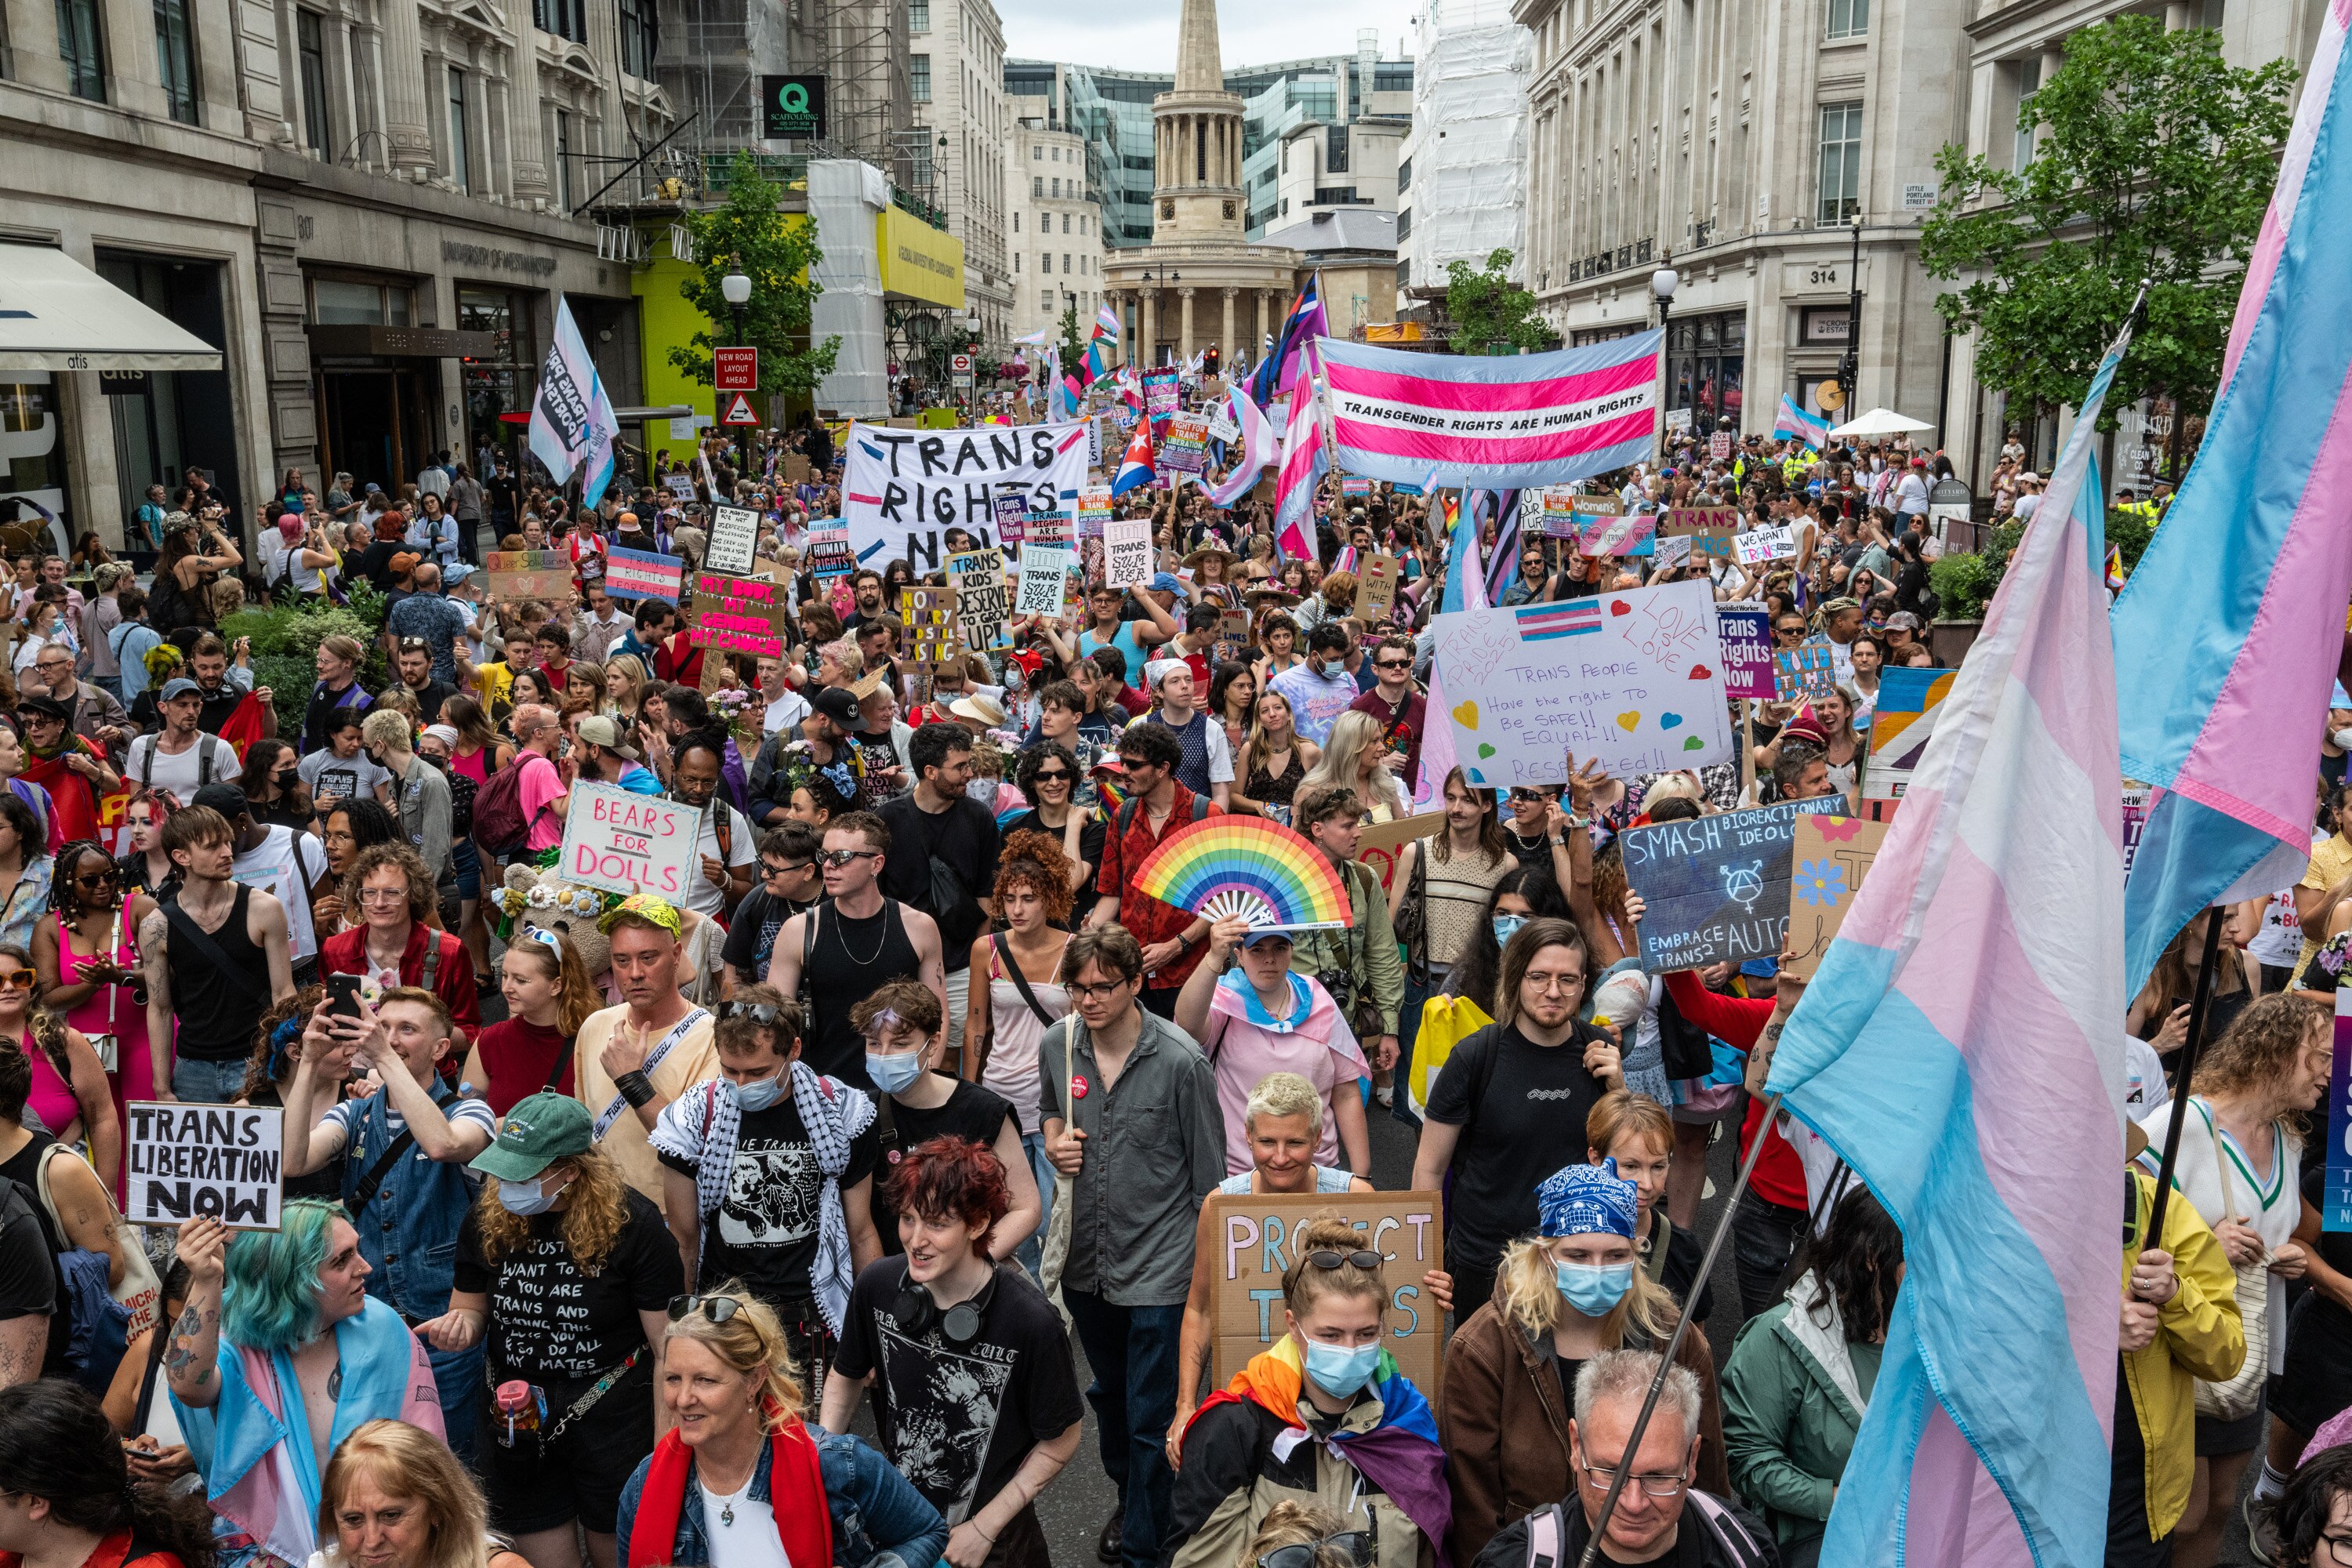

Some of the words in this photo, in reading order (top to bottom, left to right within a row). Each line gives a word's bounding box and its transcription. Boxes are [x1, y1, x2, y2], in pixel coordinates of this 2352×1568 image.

[779, 83, 809, 114] Q
[492, 249, 502, 270] OF
[1810, 271, 1836, 283] 314
[67, 354, 88, 369] atis
[1344, 401, 1445, 429] TRANSGENDER
[1451, 420, 1504, 431] RIGHTS
[1510, 418, 1538, 430] ARE
[1544, 408, 1592, 427] HUMAN
[1597, 393, 1644, 416] RIGHTS
[1171, 420, 1191, 430] FIGHT
[1192, 424, 1205, 433] FOR
[1167, 437, 1203, 449] LIBERATION
[1175, 430, 1199, 441] TRANS
[873, 430, 1054, 477] TRANS
[1176, 447, 1203, 456] SOCIALISM
[2130, 449, 2150, 461] CLEAN
[2135, 461, 2143, 470] CO
[994, 498, 1021, 511] Trans
[829, 521, 847, 530] RIGHTS
[1671, 509, 1738, 528] TRANS
[821, 531, 837, 541] ARE
[1001, 524, 1022, 537] Now
[1607, 533, 1624, 542] TRANS
[1635, 532, 1653, 540] YOUTH
[1698, 528, 1709, 536] IS
[1739, 535, 1756, 547] WE
[1757, 528, 1784, 543] WANT
[813, 543, 847, 556] HUMAN
[1111, 541, 1147, 554] TRANS
[1740, 543, 1779, 561] TRANS
[487, 554, 519, 570] Queer
[628, 554, 666, 569] TRANS
[815, 557, 848, 571] RIGHTS
[953, 552, 1000, 574] TRANS
[1026, 550, 1063, 568] HOT
[625, 567, 665, 583] RIGHTS
[963, 572, 992, 588] KIDS
[1025, 570, 1061, 582] TRANS
[616, 581, 670, 600] FOREVER!
[701, 576, 726, 593] MY
[1366, 578, 1392, 592] WITH
[724, 597, 746, 614] MY
[956, 585, 1008, 616] DESERVE
[1366, 591, 1388, 604] THE
[902, 608, 951, 625] BINARY
[960, 615, 976, 626] TO
[979, 609, 1010, 624] GROW
[691, 628, 715, 645] MY
[903, 627, 924, 640] AND
[926, 627, 954, 640] STILL
[967, 622, 1003, 652] UP!
[1224, 633, 1247, 643] LIVES
[902, 643, 954, 662] EXISTING
[1719, 639, 1769, 667] Rights
[1777, 648, 1830, 673] WOULD
[1505, 666, 1570, 684] TRANS
[1805, 669, 1835, 684] HERE
[1486, 696, 1523, 713] Have
[1535, 695, 1559, 707] the
[1569, 691, 1611, 707] right
[321, 775, 354, 785] TRANS
[593, 798, 675, 836] BEARS
[1627, 819, 1722, 865] SMASH
[1722, 797, 1842, 831] BIOREACTIONARY
[614, 833, 648, 854] FOR
[575, 843, 677, 892] DOLLS
[1648, 925, 1724, 953] EMBRACE
[671, 1009, 709, 1039] Fiorucci
[642, 1040, 673, 1075] iorucci
[130, 1108, 261, 1146] TRANS
[131, 1144, 278, 1184] LIBERATION
[1568, 1186, 1592, 1195] shots
[1602, 1185, 1623, 1195] calling
[147, 1181, 268, 1224] NOW
[503, 1261, 547, 1278] WANT
[517, 1279, 543, 1296] YOU
[549, 1284, 583, 1298] ARE
[493, 1294, 543, 1315] TRANS
[556, 1305, 589, 1319] AND
[575, 1339, 602, 1354] ALL
[971, 1341, 1018, 1363] CULT
[506, 1354, 524, 1368] MY
[539, 1358, 596, 1370] MATES
